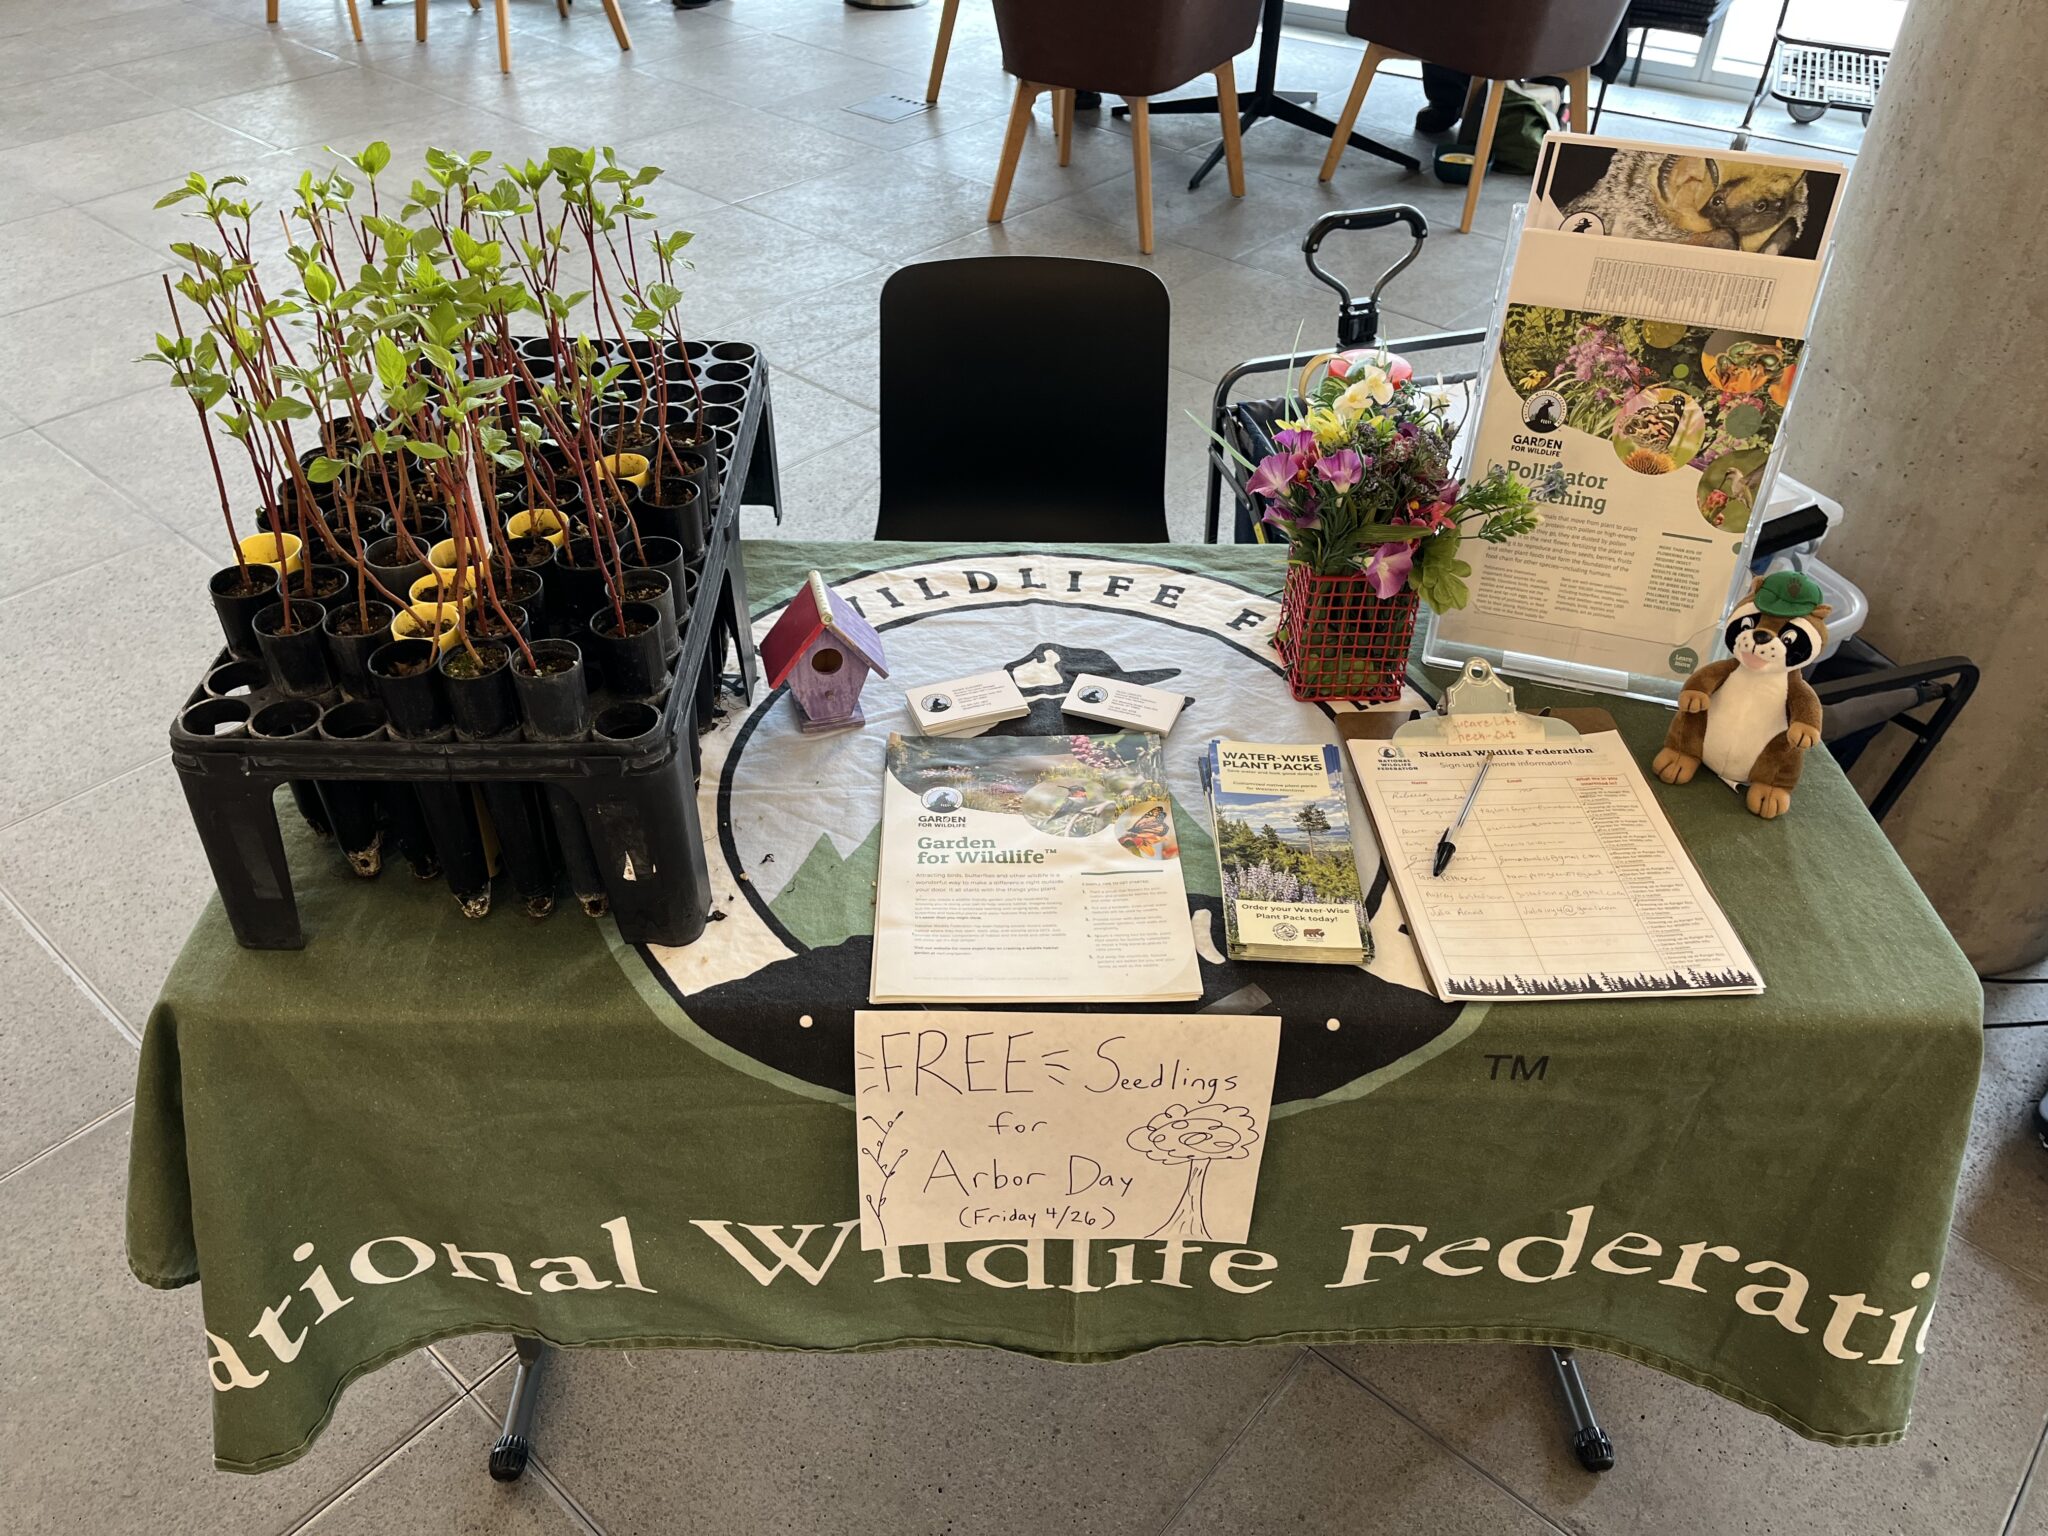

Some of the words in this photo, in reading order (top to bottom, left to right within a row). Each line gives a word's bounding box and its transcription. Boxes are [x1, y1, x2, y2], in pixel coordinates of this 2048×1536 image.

[1513, 435, 1562, 449] GARDEN
[1528, 447, 1560, 457] WILDLIFE
[1508, 460, 1608, 489] Polliator
[1223, 752, 1319, 762] WATER-WISE
[1418, 750, 1472, 758] National
[1474, 748, 1524, 757] Wildlife
[1527, 747, 1593, 755] Federation
[1223, 761, 1269, 769] PLANT
[1440, 761, 1461, 769] Sign
[918, 837, 996, 849] Garden
[917, 852, 949, 864] for
[880, 1031, 1034, 1096] FREE
[1084, 1036, 1237, 1104] Seedlings
[1484, 1054, 1549, 1081] TM
[988, 1111, 1048, 1135] for
[923, 1150, 1046, 1197] Arbor
[1065, 1155, 1133, 1198] Day
[959, 1206, 1036, 1229] (Friday
[1046, 1207, 1116, 1230] 4/26)
[206, 1215, 657, 1392] ational
[1325, 1205, 1935, 1365] Federati
